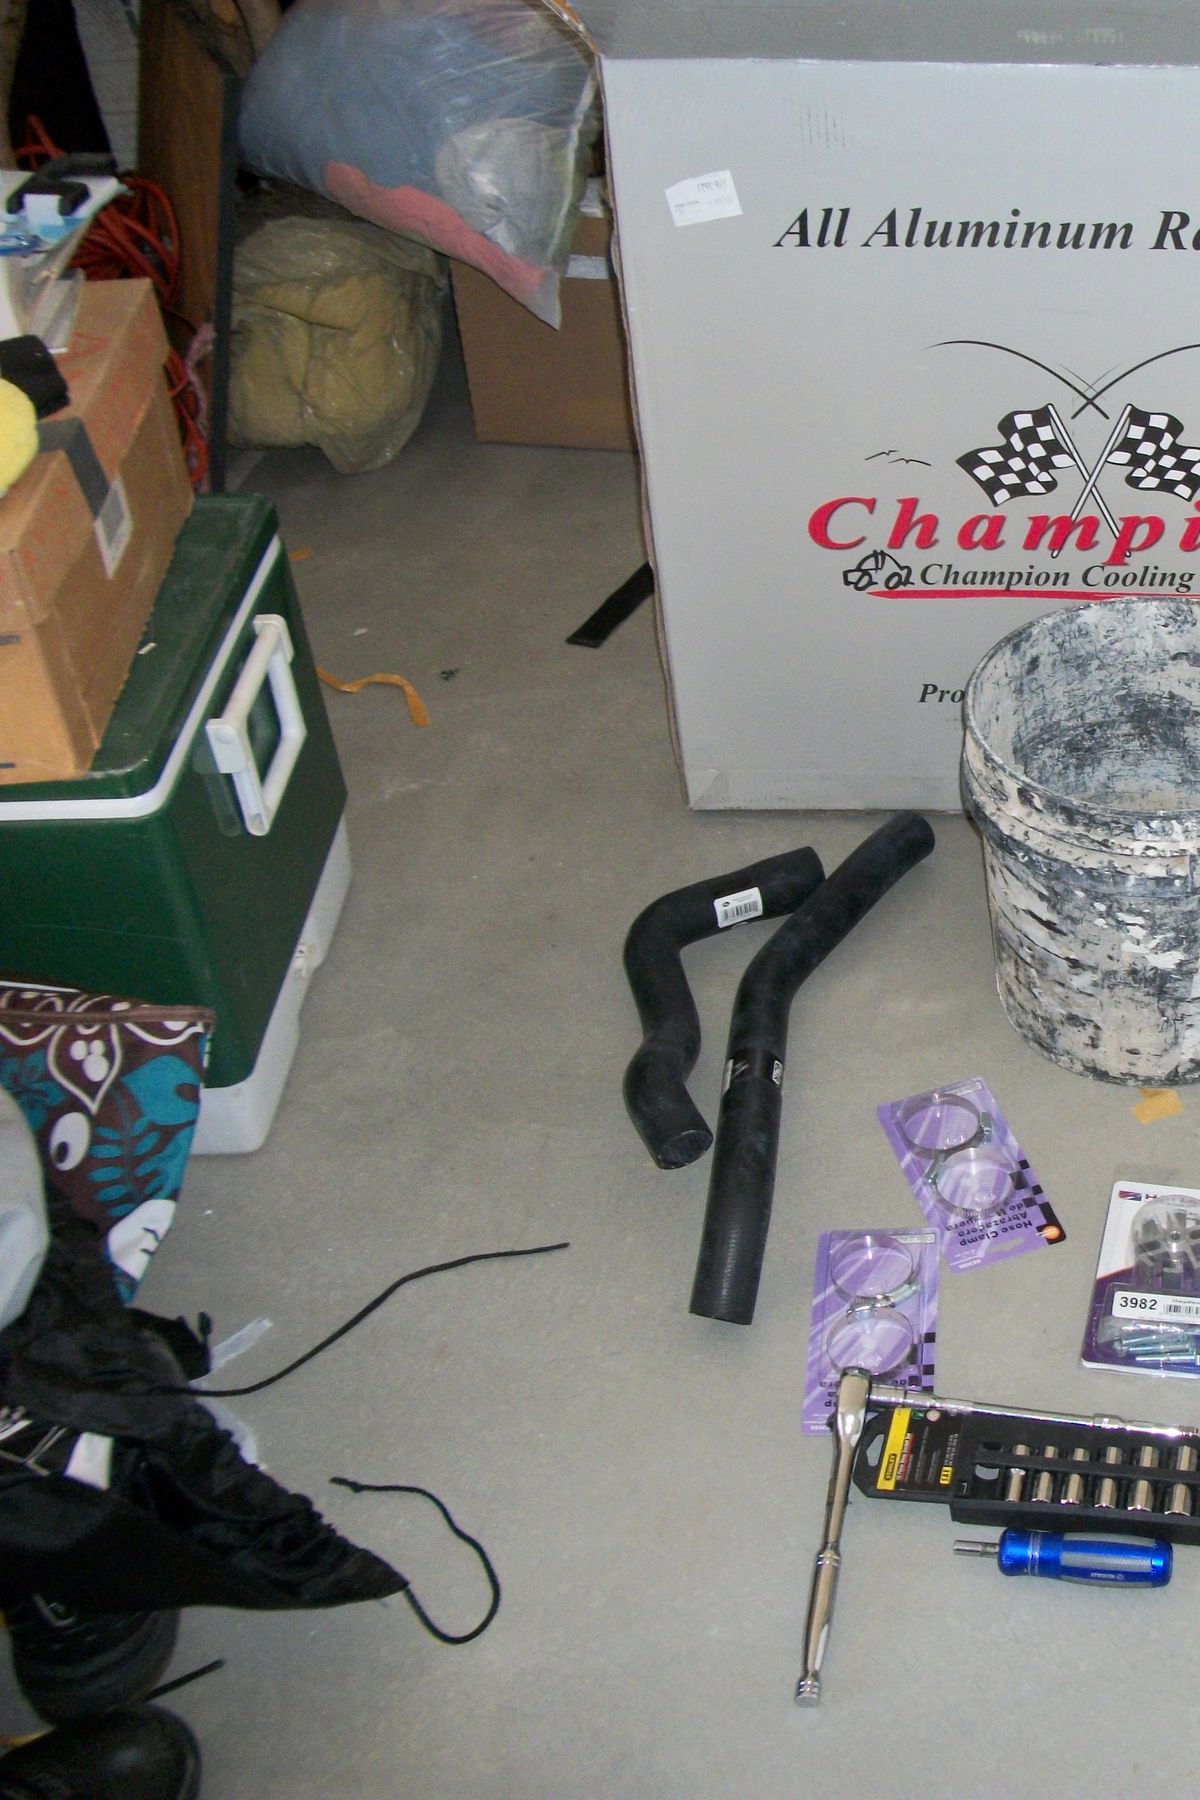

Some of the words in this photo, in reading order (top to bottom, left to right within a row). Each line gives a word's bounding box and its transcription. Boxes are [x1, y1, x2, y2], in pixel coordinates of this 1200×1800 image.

[772, 207, 851, 249] All
[860, 207, 1135, 250] Aluminum
[919, 563, 1070, 591] Champion
[1080, 564, 1195, 592] Cooling
[1000, 1219, 1033, 1235] Hose
[959, 1229, 998, 1248] Clamp
[1119, 1296, 1158, 1310] 3982
